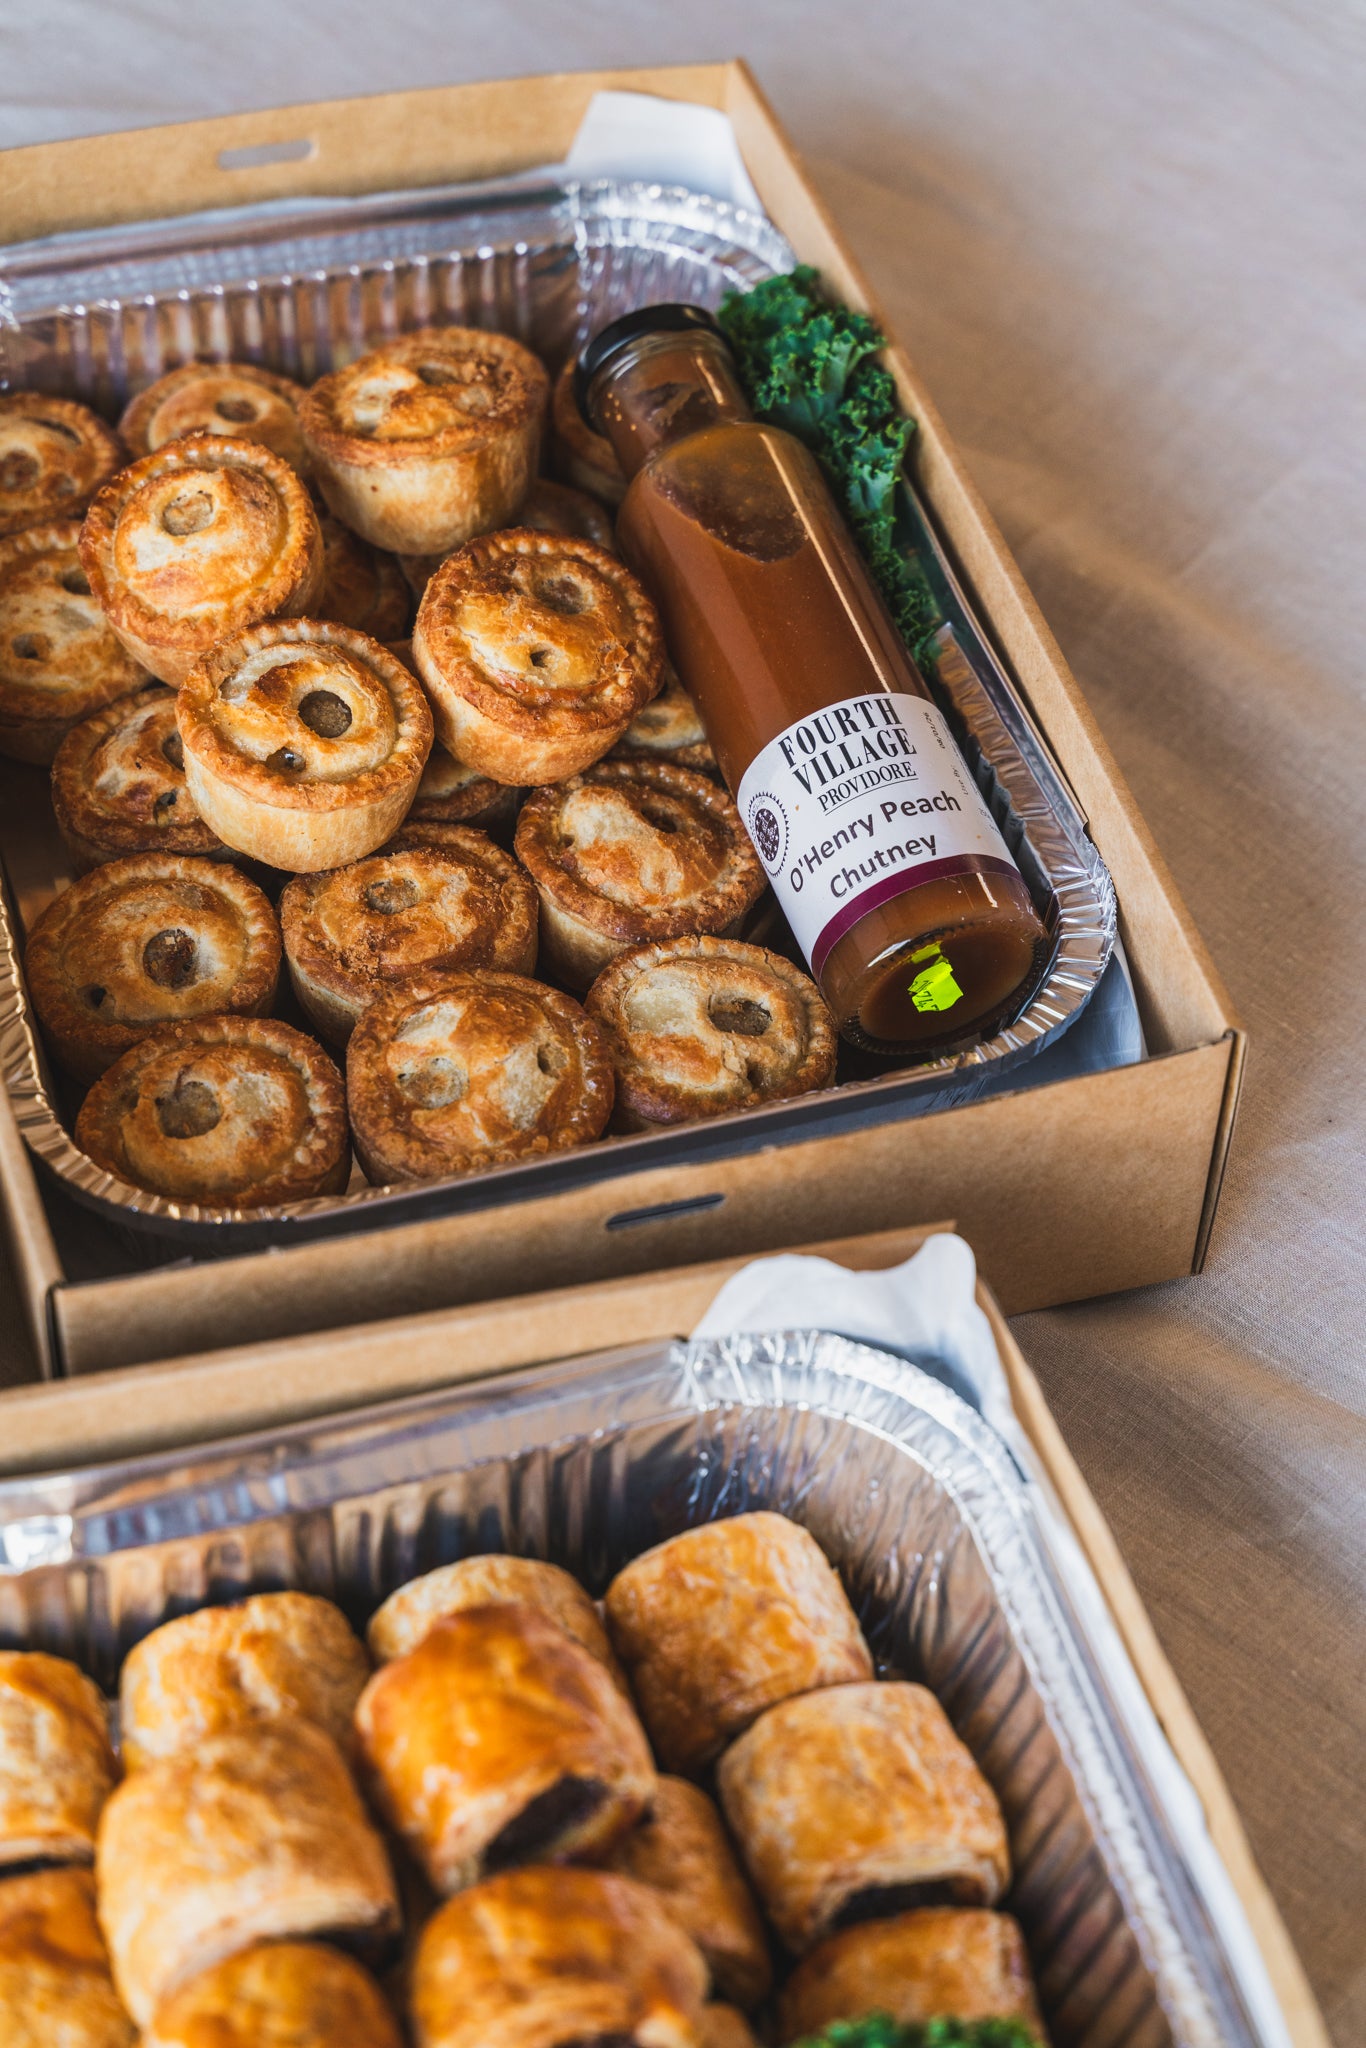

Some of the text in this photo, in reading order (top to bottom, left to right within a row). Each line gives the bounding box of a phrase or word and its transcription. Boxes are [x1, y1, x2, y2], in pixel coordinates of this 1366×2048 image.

[778, 698, 902, 769] FOURTH
[792, 728, 917, 795] VILLAGE
[817, 761, 917, 812] PROVIDORE
[790, 813, 875, 893] O'Henry
[880, 790, 962, 823] Peach
[830, 834, 937, 899] Chutney
